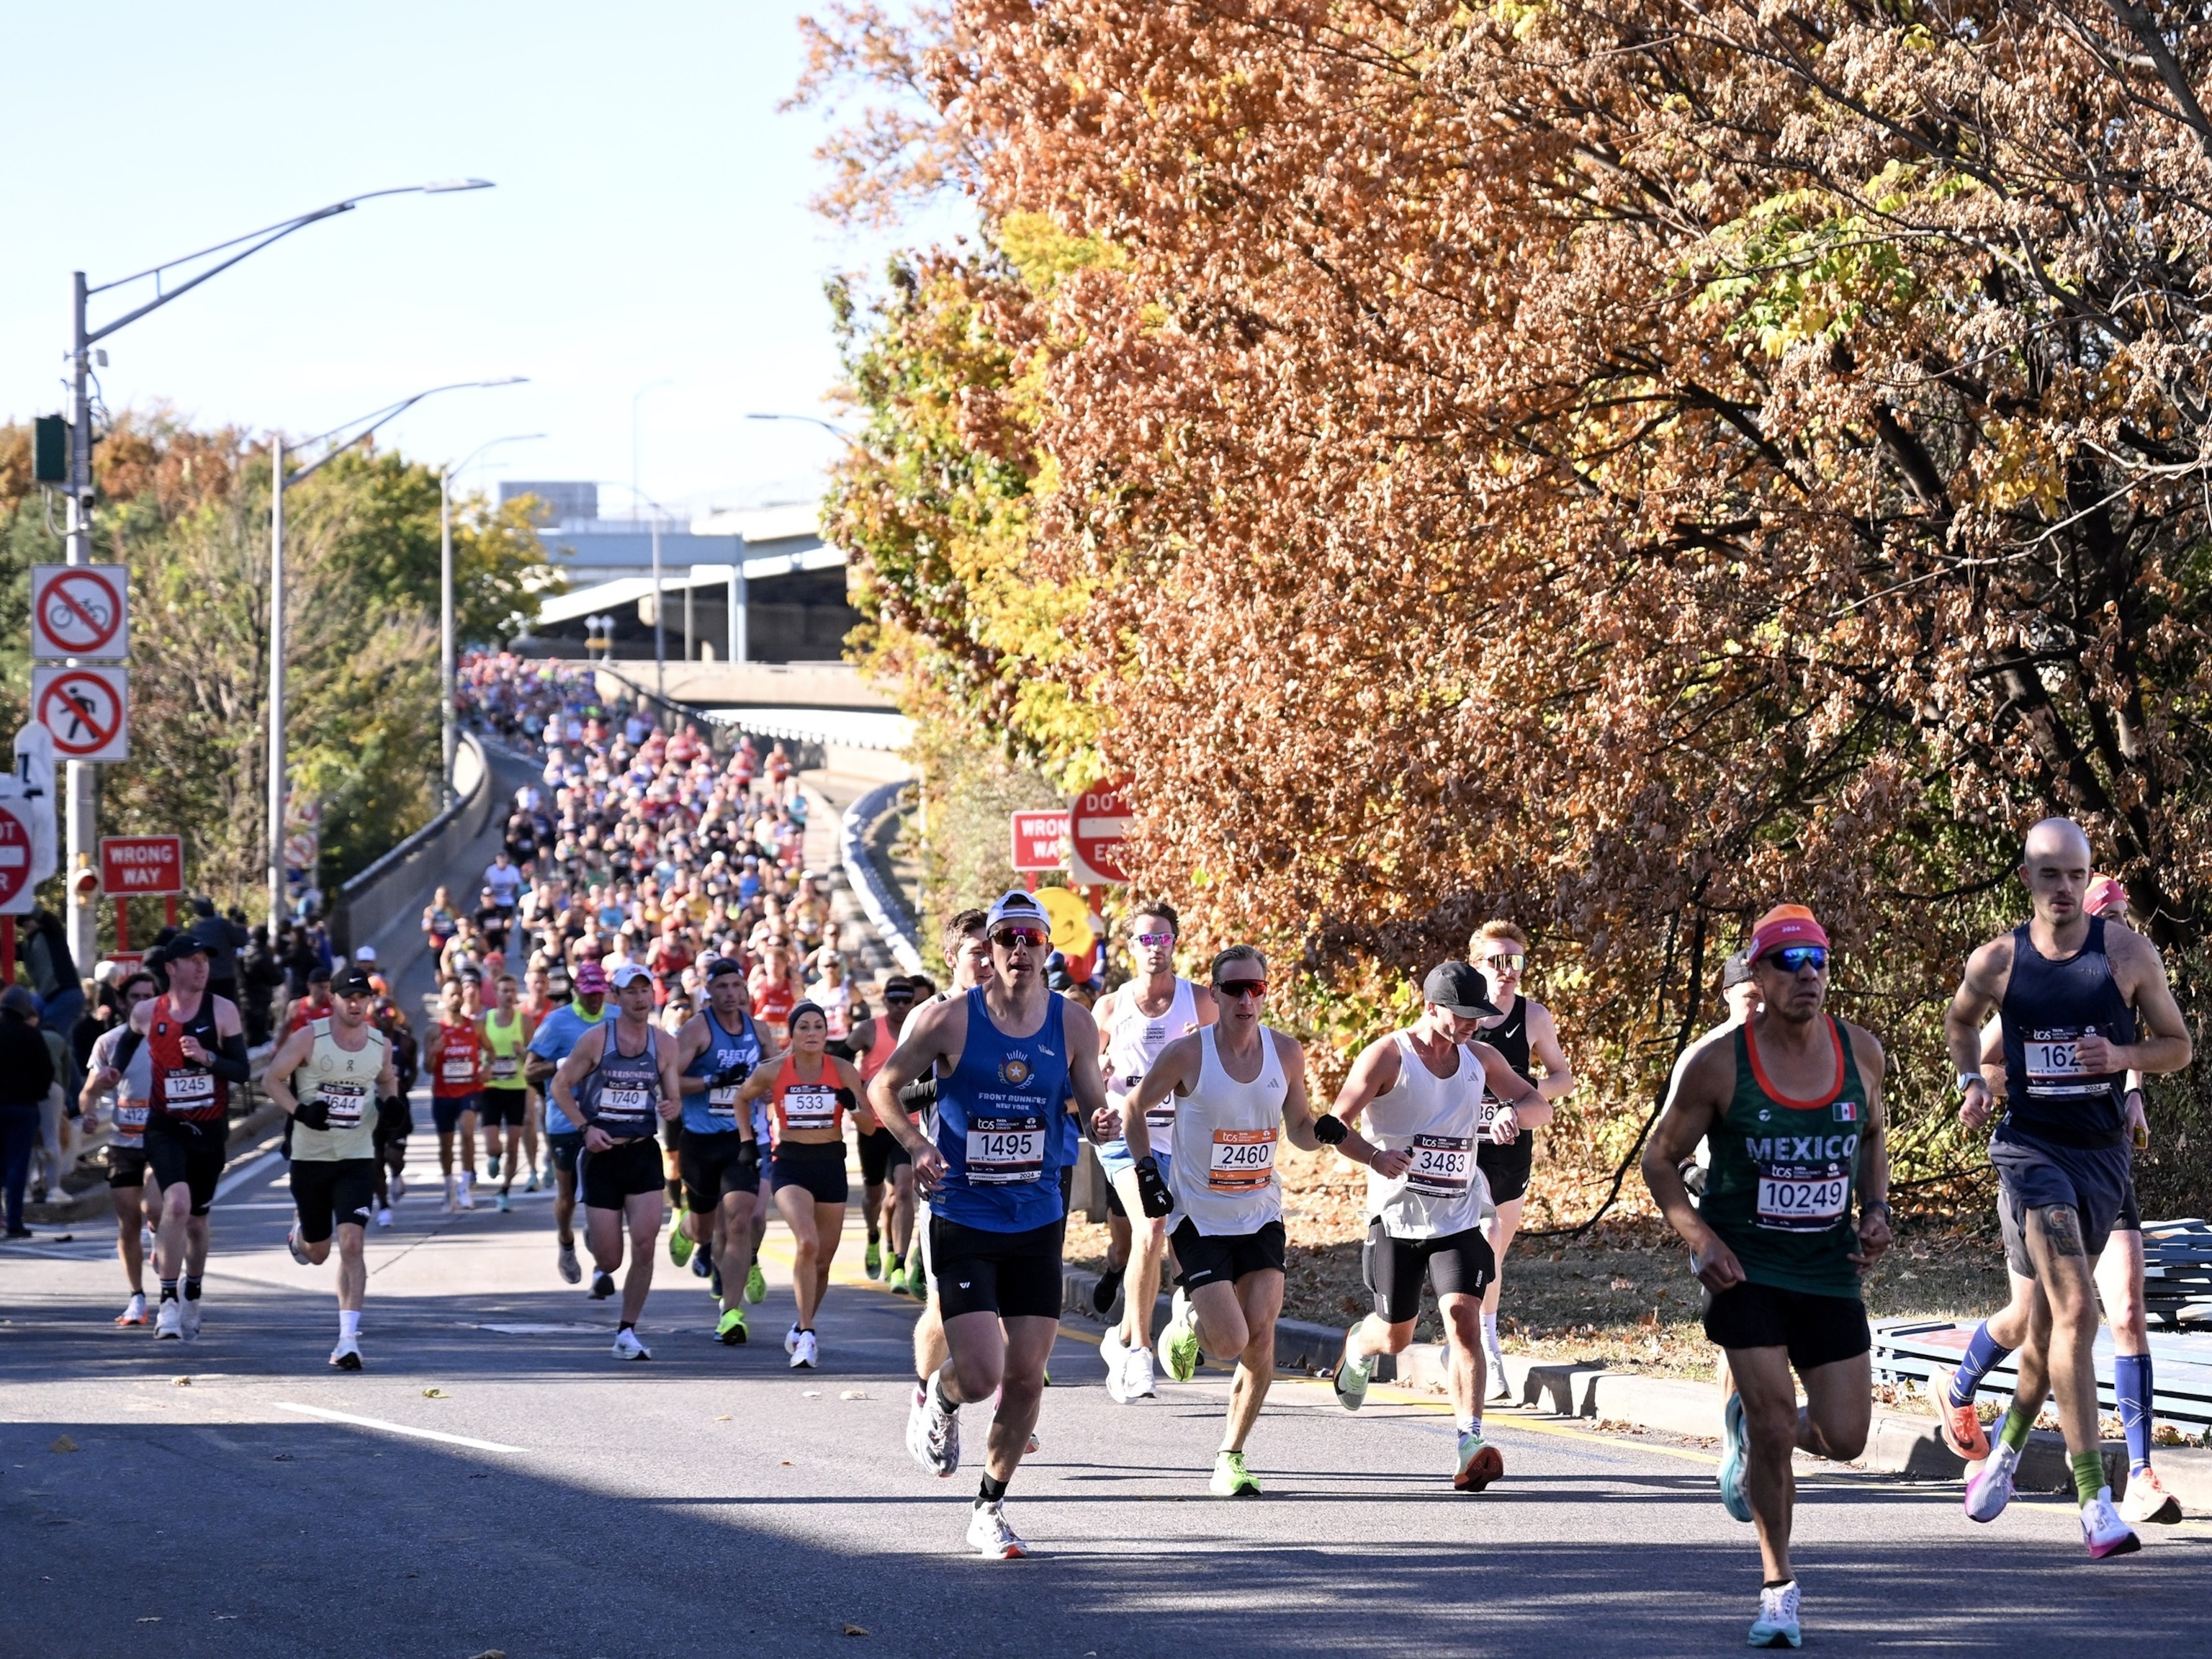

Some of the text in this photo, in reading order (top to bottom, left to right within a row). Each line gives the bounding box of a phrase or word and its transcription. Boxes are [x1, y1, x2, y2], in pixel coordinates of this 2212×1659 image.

[1086, 793, 1113, 811] DO
[1021, 819, 1069, 837] WRON
[109, 845, 173, 863] WRONG
[1033, 841, 1059, 858] WA
[122, 868, 161, 886] WAY
[2033, 1029, 2051, 1040] tcs
[717, 1049, 747, 1059] FLEET
[2041, 1044, 2082, 1067] 162
[174, 1078, 205, 1092] 1245
[325, 1094, 357, 1110] 1644
[611, 1091, 639, 1105] 1740
[796, 1095, 823, 1110] 533
[978, 1092, 1047, 1105] FRONT RUNNERS
[977, 1118, 995, 1130] tcs
[981, 1134, 1033, 1156] 1495
[1223, 1132, 1238, 1142] tcs
[1421, 1136, 1437, 1148] tcs
[1222, 1144, 1269, 1164] 2460
[1745, 1133, 1858, 1161] MEXICO
[1420, 1151, 1465, 1173] 3483
[1771, 1164, 1792, 1179] tcs
[1766, 1182, 1842, 1208] 10249
